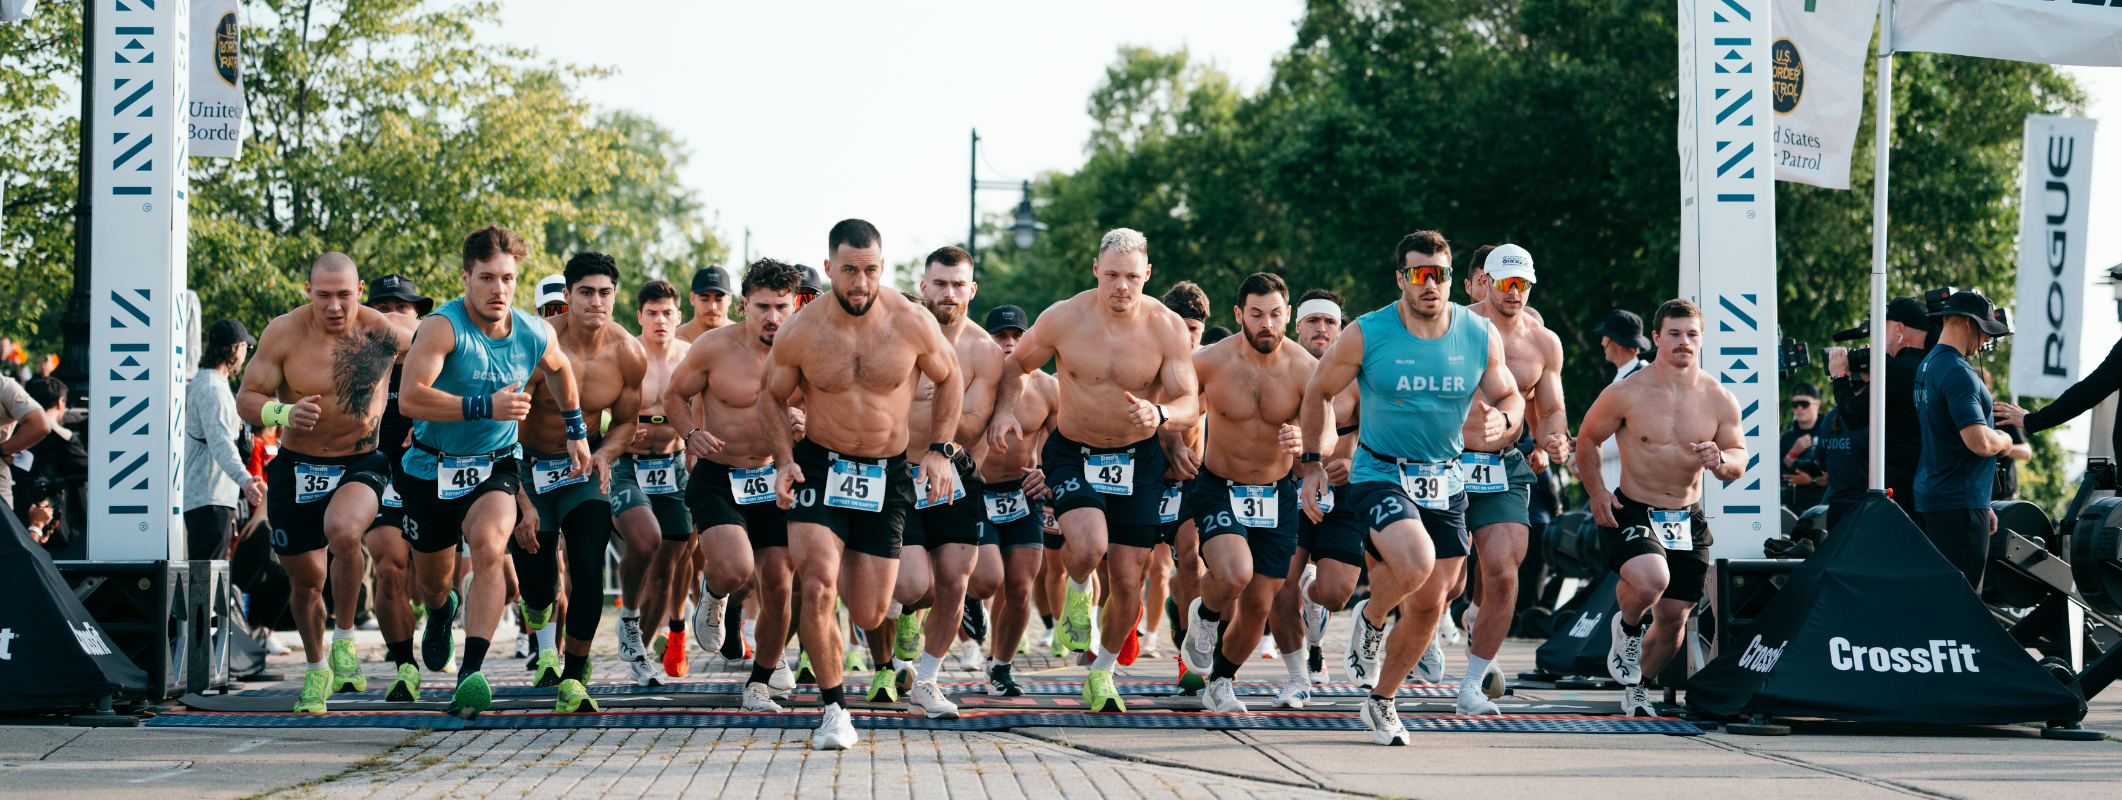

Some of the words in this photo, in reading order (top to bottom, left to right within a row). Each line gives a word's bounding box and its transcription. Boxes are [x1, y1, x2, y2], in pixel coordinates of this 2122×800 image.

[1776, 50, 1793, 63] U.S.
[112, 0, 155, 195] ENNI
[1783, 128, 1821, 149] States
[1780, 150, 1822, 171] Patrol
[2042, 135, 2074, 378] ROGUE
[1396, 375, 1466, 392] ADLER
[304, 474, 330, 493] 35
[452, 467, 480, 489] 48
[646, 469, 667, 486] 42
[1098, 465, 1123, 485] 43
[1471, 465, 1491, 484] 41
[744, 477, 769, 496] 46
[840, 476, 870, 499] 45
[1051, 476, 1081, 501] 38
[1414, 477, 1438, 499] 39
[611, 488, 632, 512] 37
[995, 498, 1018, 515] 52
[1243, 497, 1264, 518] 31
[1369, 496, 1403, 526] 23
[402, 514, 419, 541] 43
[1202, 510, 1233, 534] 26
[1662, 522, 1683, 540] 32
[1621, 524, 1651, 542] 27
[1347, 649, 1366, 680] TYR
[1828, 636, 1981, 674] CrossFit
